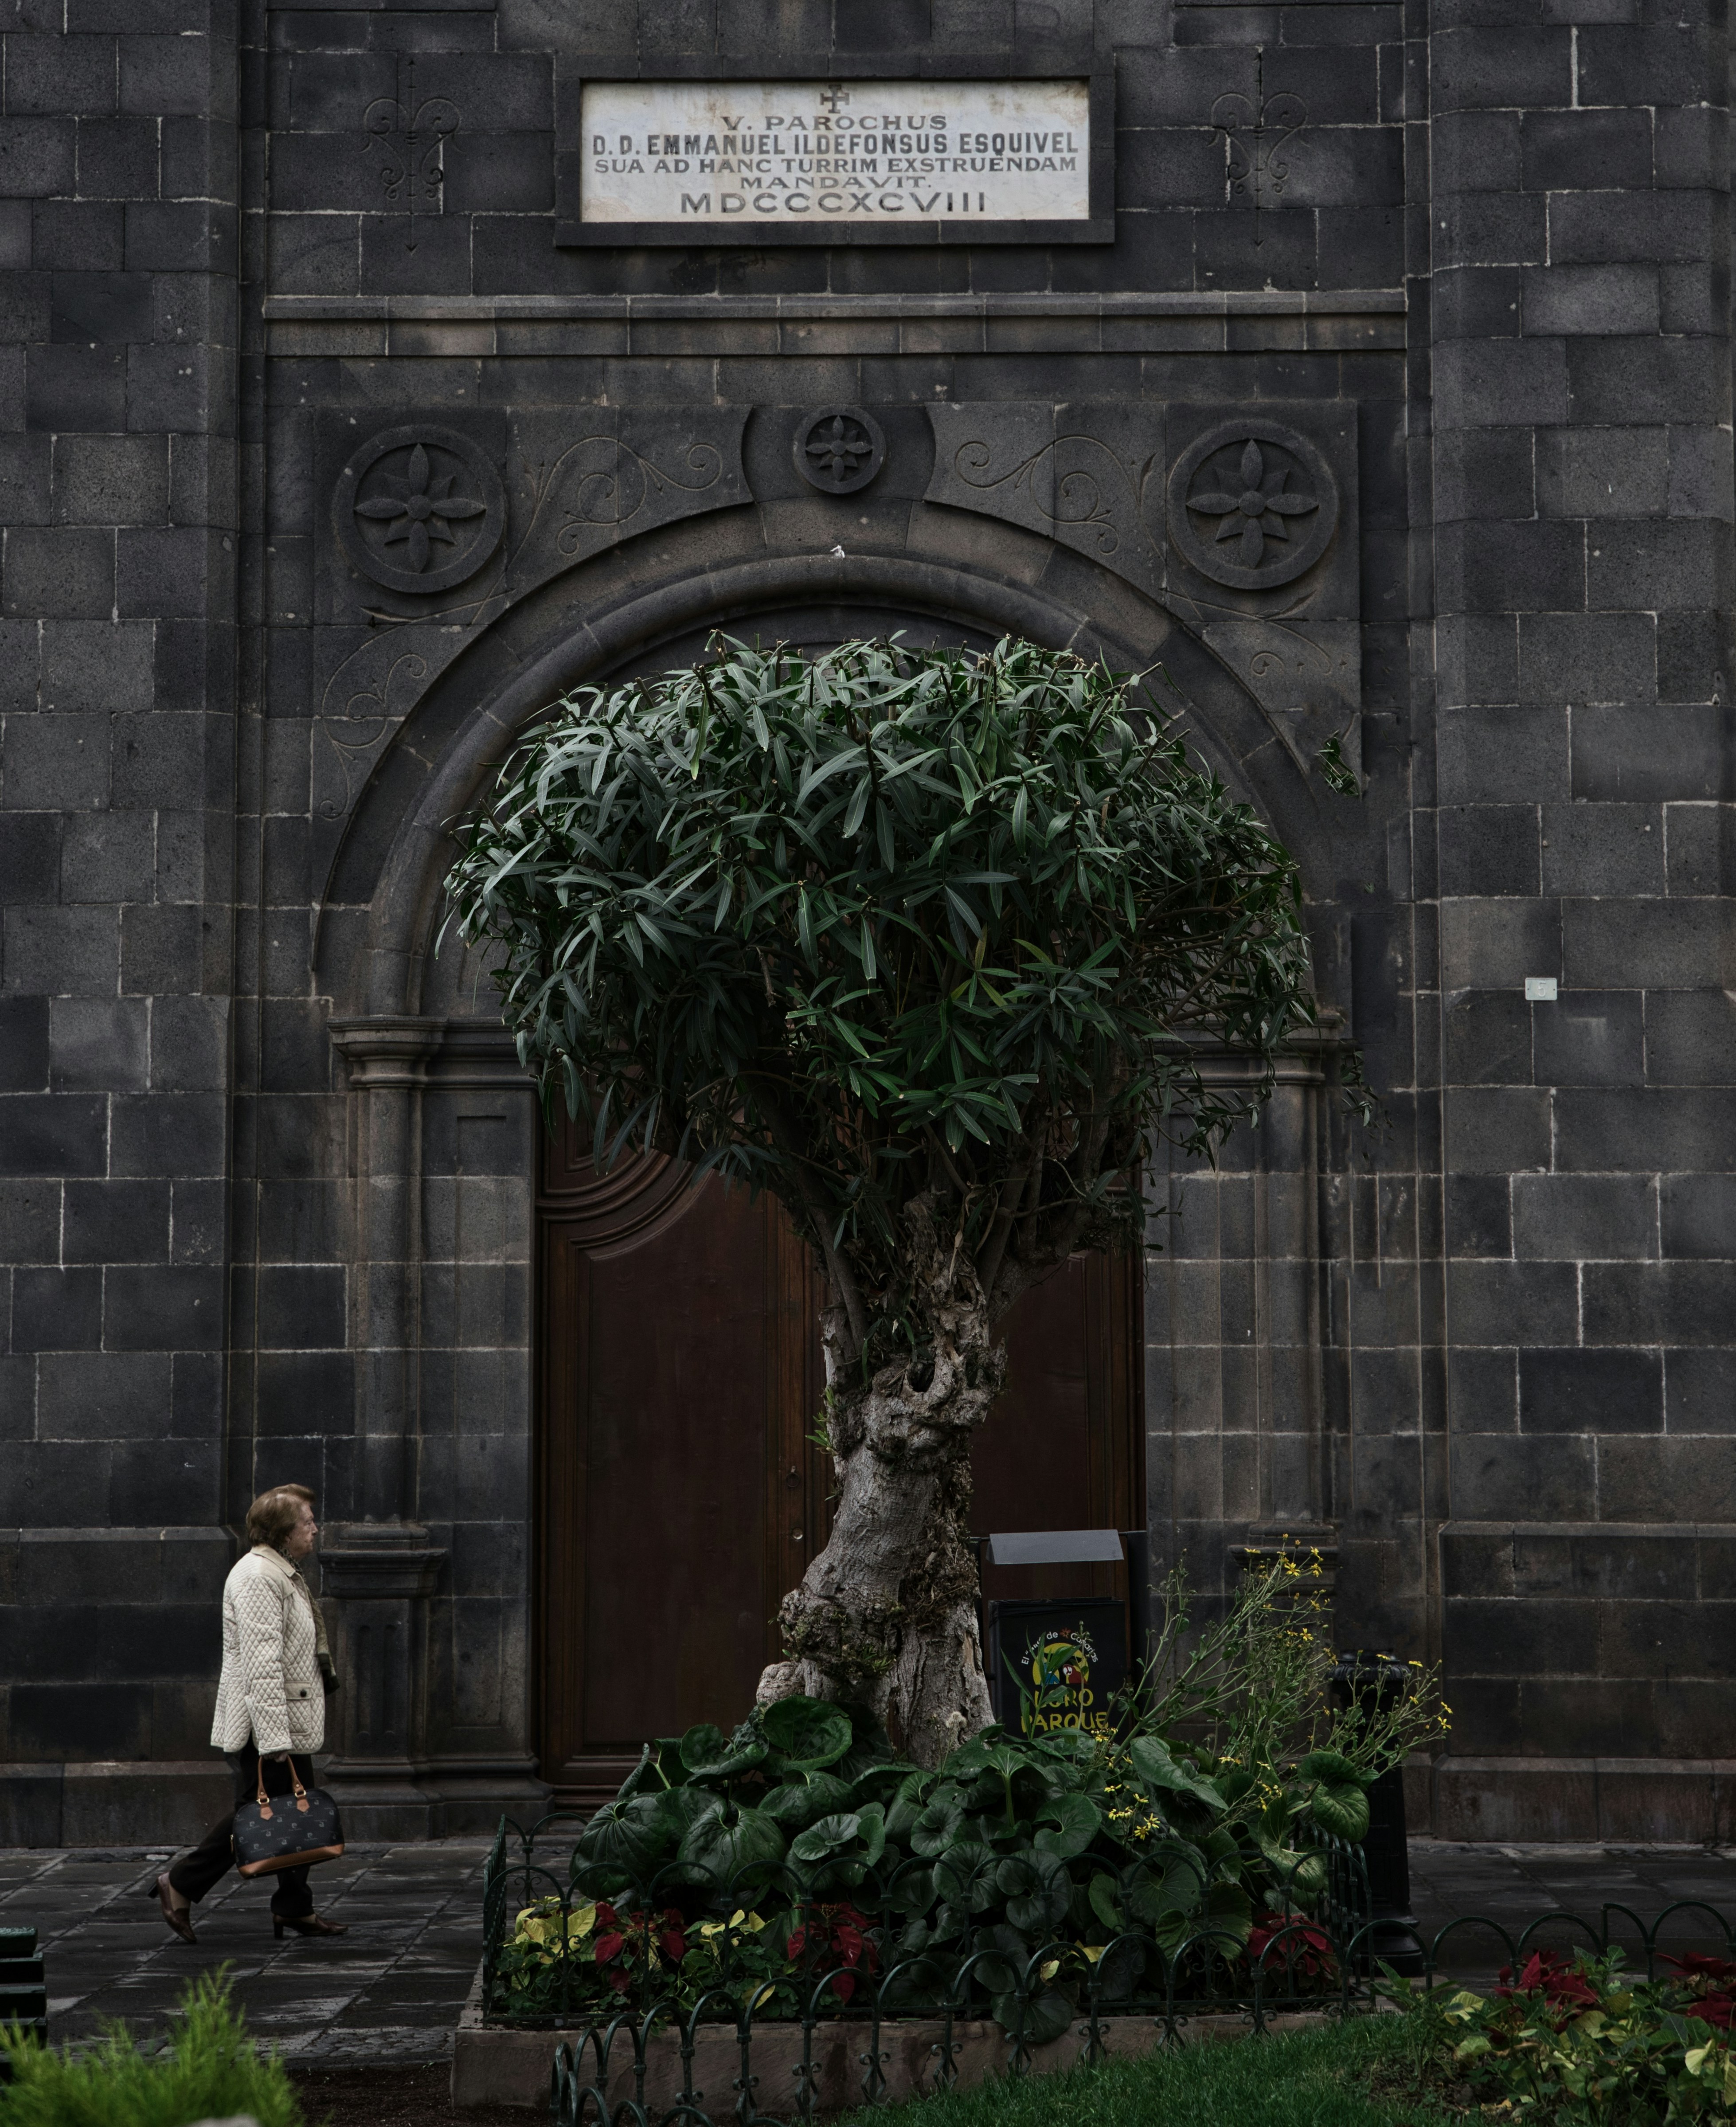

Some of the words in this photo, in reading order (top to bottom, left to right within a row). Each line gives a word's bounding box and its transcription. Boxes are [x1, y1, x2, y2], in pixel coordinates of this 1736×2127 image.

[720, 116, 752, 131] V.
[765, 116, 947, 131] PAROCHUS
[647, 134, 786, 155] EMMANUEL
[794, 133, 947, 155] ILDEFONSUS
[959, 132, 1079, 156] ESQUIVEL
[594, 159, 645, 173] SUA
[653, 159, 690, 173] AD
[699, 159, 771, 173] HANC
[781, 158, 878, 173] TURRIM
[887, 156, 1077, 173] EXSTRUENDAM
[740, 176, 931, 189] MANDAVIT.
[681, 192, 985, 213] MDCCCXCVIII
[1537, 981, 1547, 997] 5
[1021, 1656, 1030, 1665] El
[1046, 1631, 1059, 1640] de
